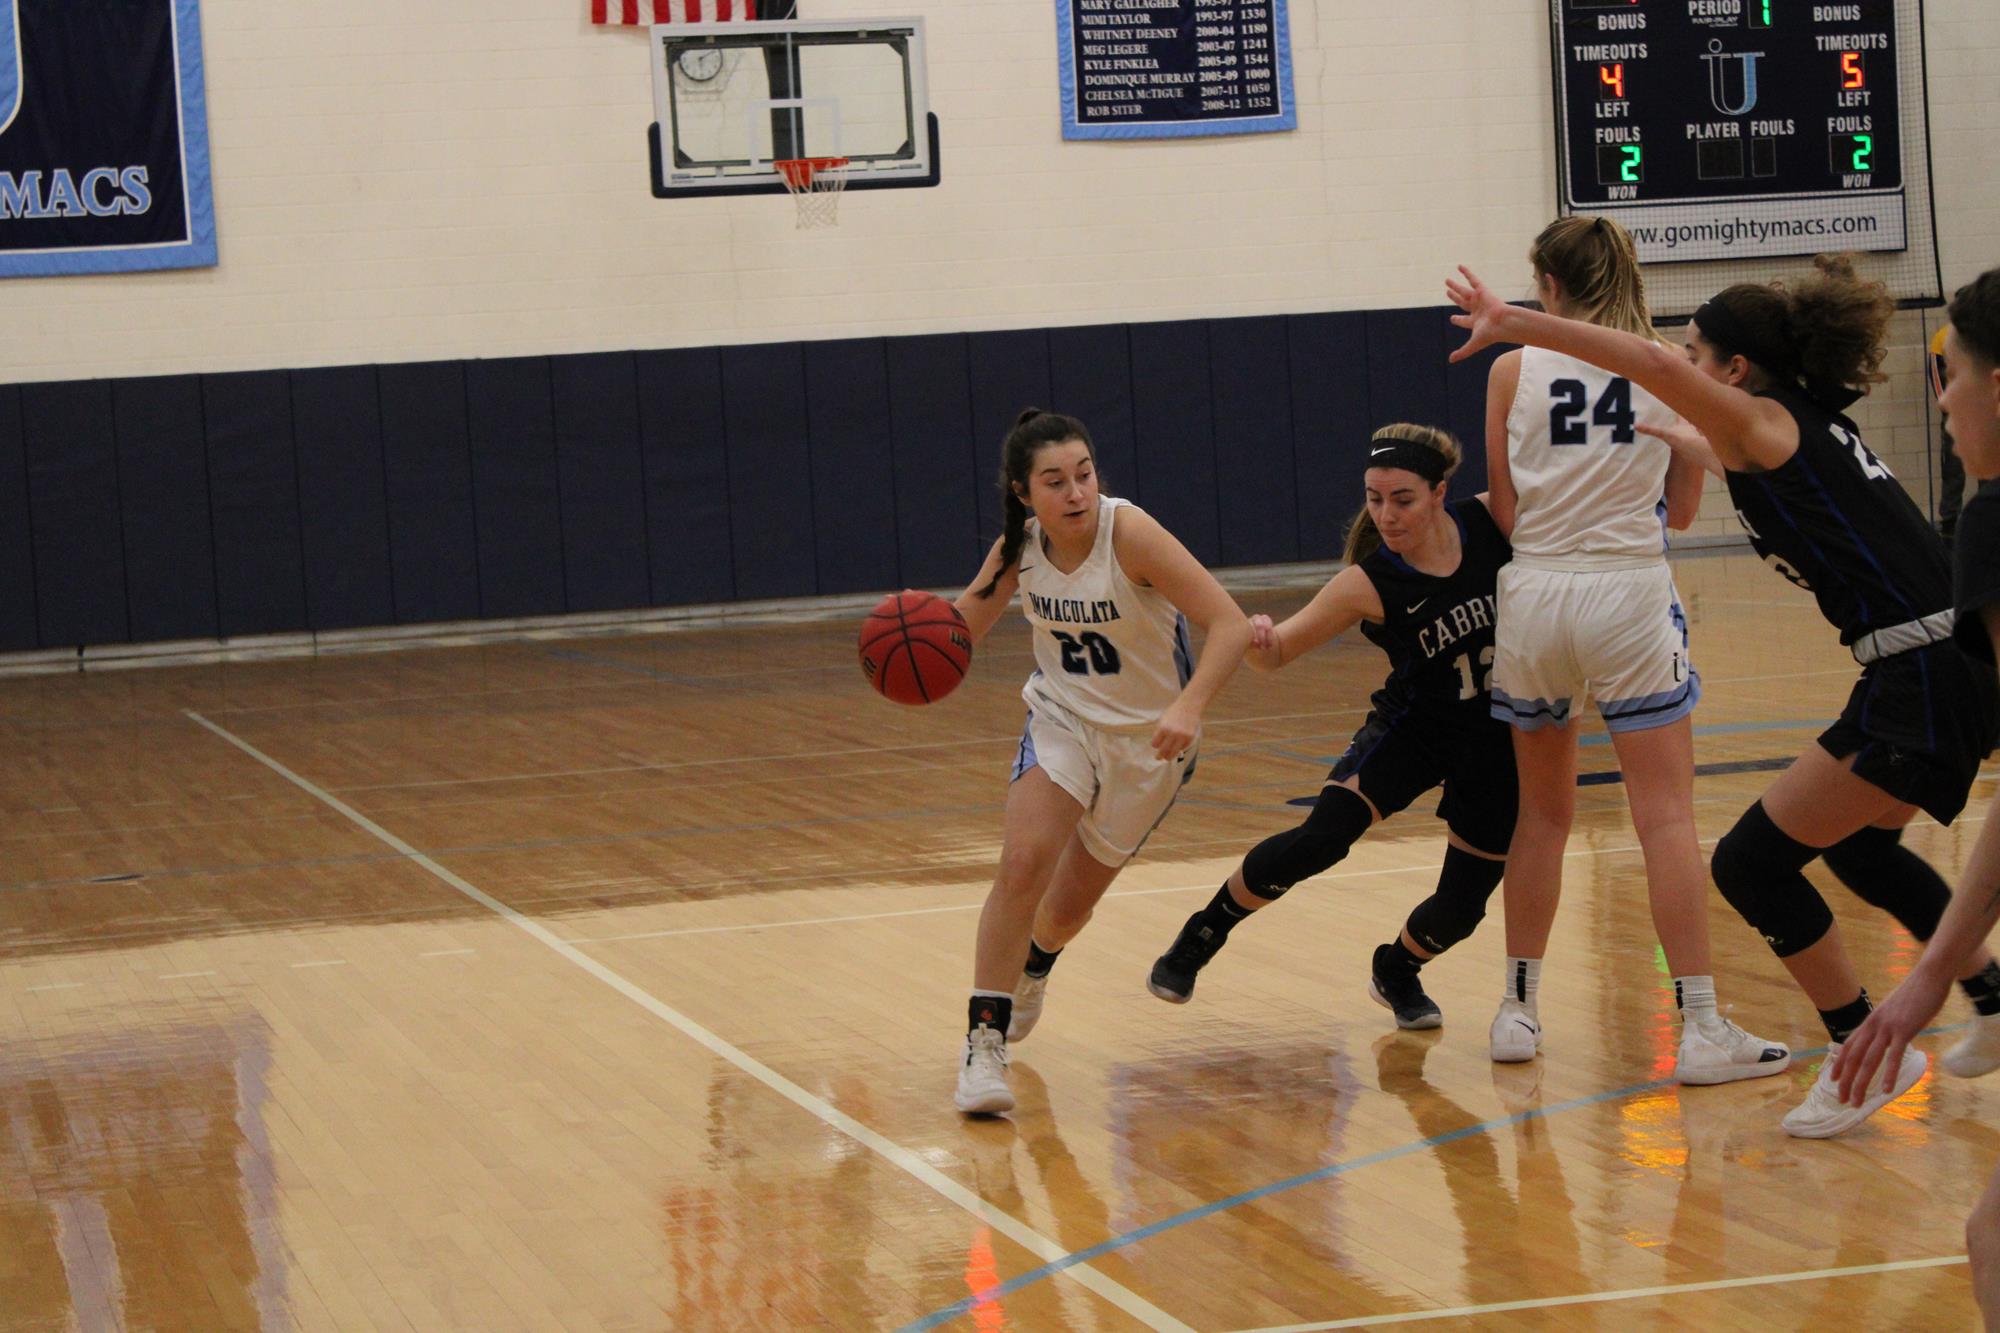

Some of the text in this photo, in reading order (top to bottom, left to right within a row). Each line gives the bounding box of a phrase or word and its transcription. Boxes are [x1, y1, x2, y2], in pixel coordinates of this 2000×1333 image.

[1688, 0, 1741, 16] PERIOD
[1813, 5, 1861, 22] BONUS
[1108, 13, 1151, 24] TAYLOR
[1597, 13, 1647, 30] BONUS
[1082, 29, 1133, 40] WHITNEY
[1135, 28, 1179, 39] DEENEY
[1815, 33, 1888, 51] TIMEOUTS
[1083, 45, 1106, 55] MEG
[1108, 44, 1149, 55] LEGERE
[1573, 43, 1649, 61] TIMEOUTS
[1084, 60, 1112, 70] KYLE
[1113, 59, 1159, 70] FINKLEA
[1842, 52, 1863, 88] 5
[1085, 74, 1148, 87] DOMINIQUE
[1149, 72, 1195, 84] MURRAY
[1600, 63, 1623, 98] 4
[1085, 90, 1134, 101] CHELSEA
[1837, 91, 1871, 107] LEFT
[1086, 106, 1110, 116] ROB
[1111, 104, 1143, 115] SITER
[1595, 101, 1630, 118] LEFT
[1686, 118, 1796, 139] PLAYER FOULS
[1827, 115, 1873, 133] FOULS
[1595, 126, 1641, 144] FOULS
[1852, 135, 1872, 170] 2
[1620, 145, 1641, 181] 2
[1842, 173, 1872, 188] WON
[0, 166, 152, 218] MACS
[1608, 185, 1638, 200] WON
[1549, 377, 1636, 446] 24
[1050, 629, 1121, 676] 20
